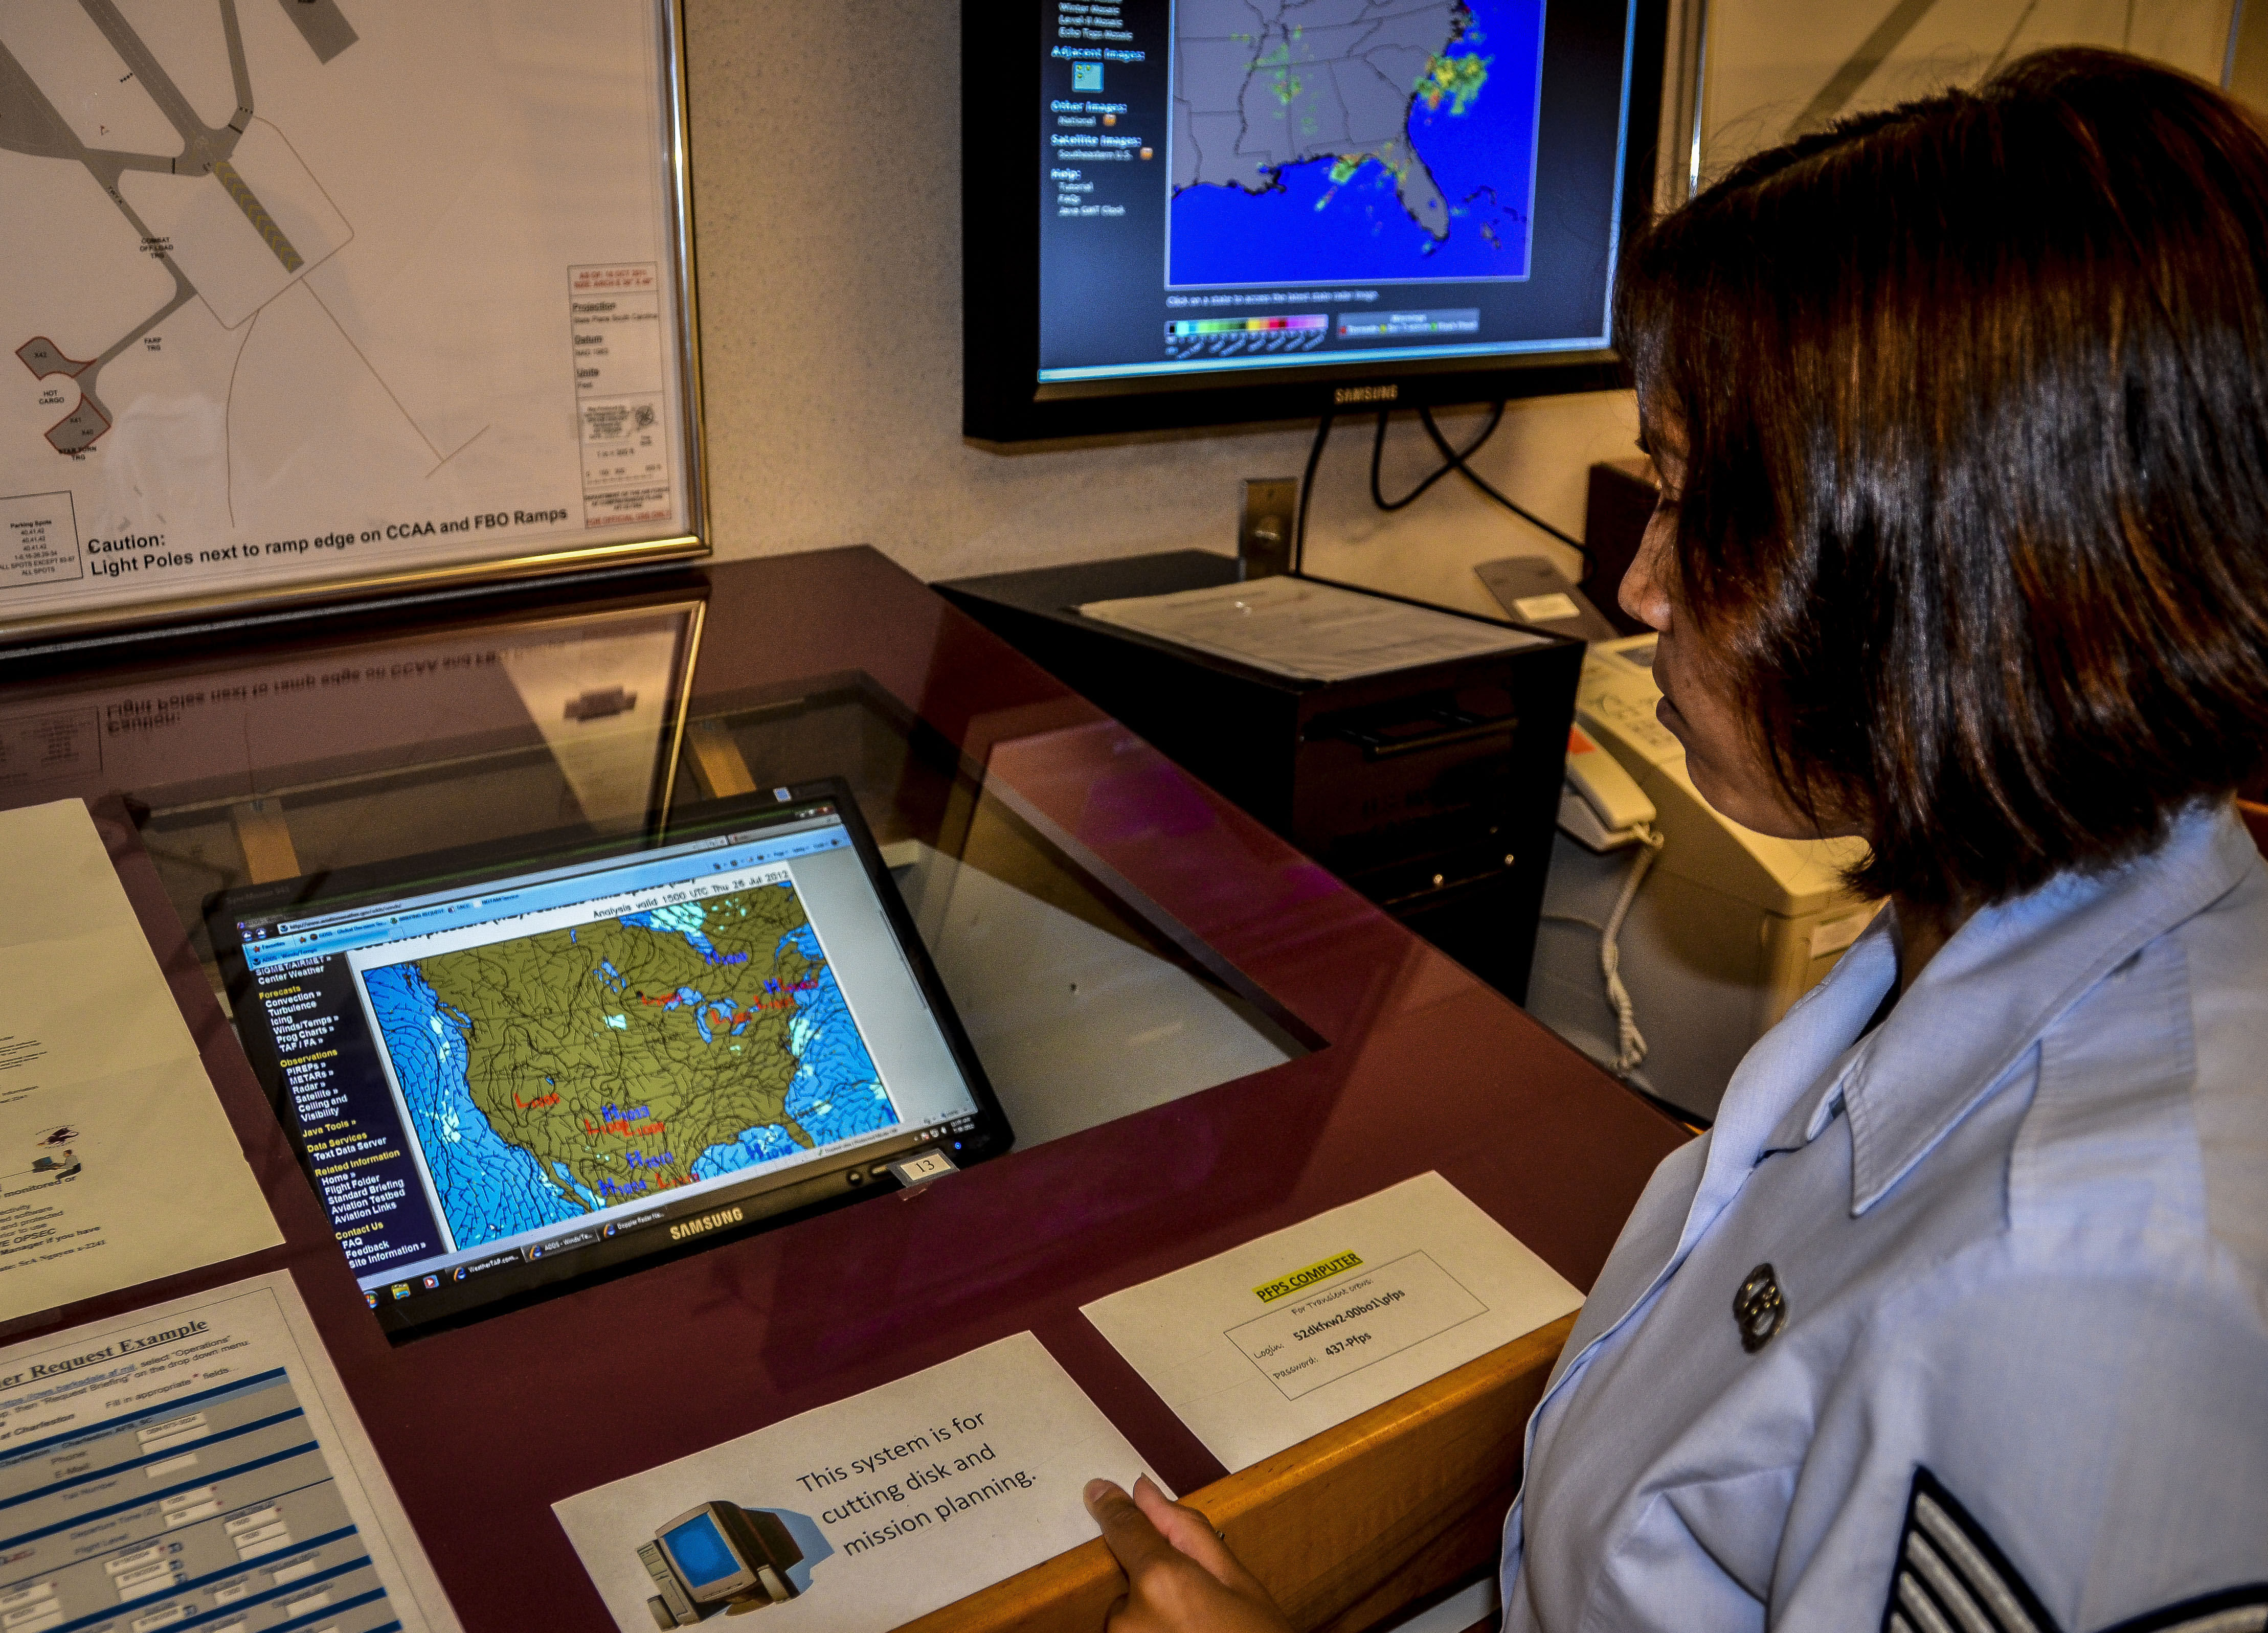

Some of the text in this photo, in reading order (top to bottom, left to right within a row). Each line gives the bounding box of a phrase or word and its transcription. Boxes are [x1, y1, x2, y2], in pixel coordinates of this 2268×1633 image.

[1051, 46, 1145, 62] Adjacent Images:
[1051, 100, 1127, 114] Other Images:
[1050, 134, 1142, 149] Satellite Images:
[87, 534, 166, 554] Caution:
[91, 557, 139, 577] Light
[144, 552, 194, 569] Poles
[199, 545, 238, 562] next
[243, 542, 259, 557] to
[265, 538, 308, 555] ramp
[313, 532, 355, 550] edge
[360, 529, 381, 542] on
[386, 520, 435, 539] CCAA
[440, 517, 470, 533] and
[474, 512, 509, 529] FBO
[513, 508, 568, 526] Ramps
[593, 904, 632, 919] Analysis
[637, 899, 659, 910] valid
[662, 891, 686, 904] 1500
[689, 887, 708, 898] UTC
[712, 883, 729, 893] Thu
[749, 876, 762, 886] Jul
[765, 870, 789, 882] 2012
[258, 965, 324, 985] Center Weather
[259, 986, 301, 1000] Forecasts
[265, 992, 315, 1008] Convection
[268, 1001, 317, 1016] Turbulence
[271, 1015, 293, 1026] Icing
[273, 1016, 332, 1035] Winds/Temps
[276, 1027, 328, 1044] Prog Charts
[279, 1042, 297, 1053] TAF
[304, 1038, 317, 1048] FA
[280, 1049, 338, 1068] Observations
[286, 1062, 319, 1076] PIREPs
[289, 1071, 327, 1085] METARs
[292, 1082, 319, 1095] Radar
[295, 1090, 331, 1104] Satellite
[298, 1094, 348, 1113] Ceiling and
[301, 1106, 339, 1122] Visibility
[303, 1120, 350, 1138] Java Tools
[307, 1132, 367, 1152] Data Services
[313, 1137, 387, 1161] Text Data Server
[315, 1150, 400, 1177] Related Information
[916, 1159, 936, 1174] 13
[4, 1179, 62, 1198] monitored
[321, 1173, 348, 1186] Home
[324, 1175, 380, 1195] Flight Folder
[327, 1178, 405, 1205] Standard Briefing
[331, 1189, 406, 1215] Aviation Testbed
[14, 1206, 53, 1219] software
[20, 1210, 64, 1227] protected
[334, 1201, 397, 1224] Aviation Links
[30, 1223, 48, 1231] use
[335, 1221, 384, 1240] Contact Us
[669, 1207, 744, 1240] SAMSUNG
[13, 1228, 56, 1244] OPSEC
[55, 1233, 75, 1242] you
[76, 1227, 101, 1236] have
[342, 1237, 364, 1250] FAQ
[345, 1240, 390, 1259] Feedback
[348, 1243, 419, 1269] Site Information
[1256, 1252, 1363, 1302] PFPS COMPUTER
[1291, 1305, 1307, 1316] For
[1308, 1288, 1348, 1309] Transient
[29, 1320, 208, 1379] Request Example
[149, 1365, 165, 1374] the
[168, 1358, 190, 1369] drop
[192, 1349, 218, 1361] down
[221, 1341, 250, 1352] menu.
[140, 1354, 169, 1367] select
[105, 1399, 121, 1408] Fill
[136, 1379, 192, 1401] appropriate
[14, 1414, 75, 1436] Charleston
[796, 1411, 985, 1493] This system is for
[821, 1442, 997, 1525] cutting disk and
[842, 1469, 1037, 1557] mission planning.
